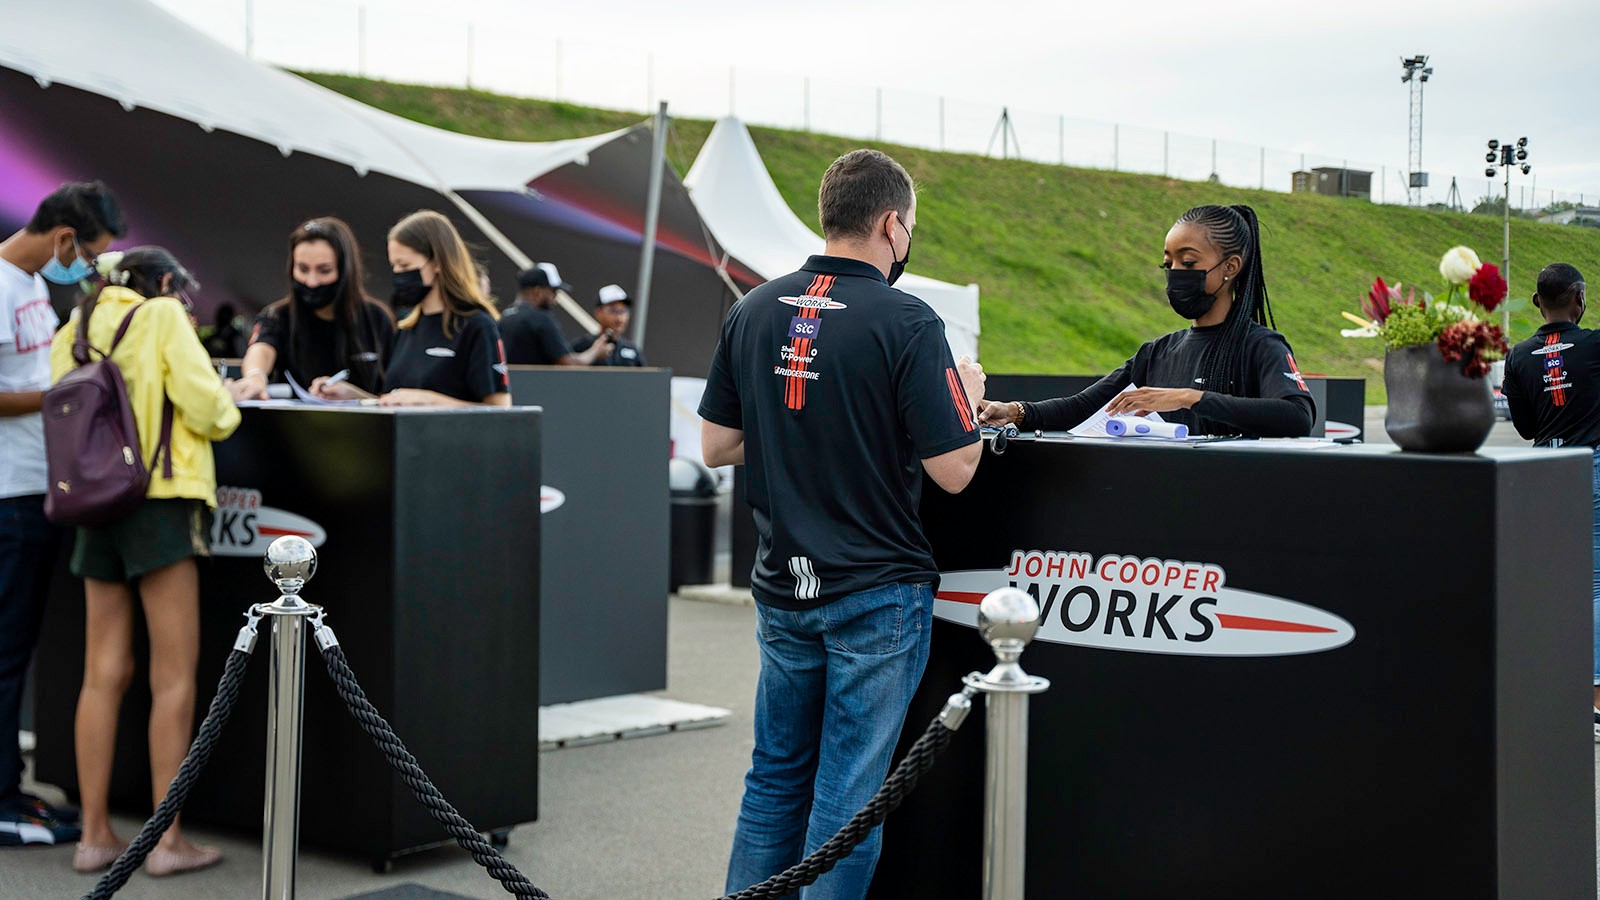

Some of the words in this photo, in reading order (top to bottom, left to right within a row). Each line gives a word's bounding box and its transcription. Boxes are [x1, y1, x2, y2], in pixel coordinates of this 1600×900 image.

[795, 299, 829, 308] WORKS
[795, 322, 815, 334] stc
[780, 352, 814, 363] V-Power
[774, 366, 820, 380] BRIDGESTONE
[1009, 555, 1088, 579] JOHN
[1100, 560, 1221, 593] COOPER
[1008, 580, 1218, 643] WORKS
